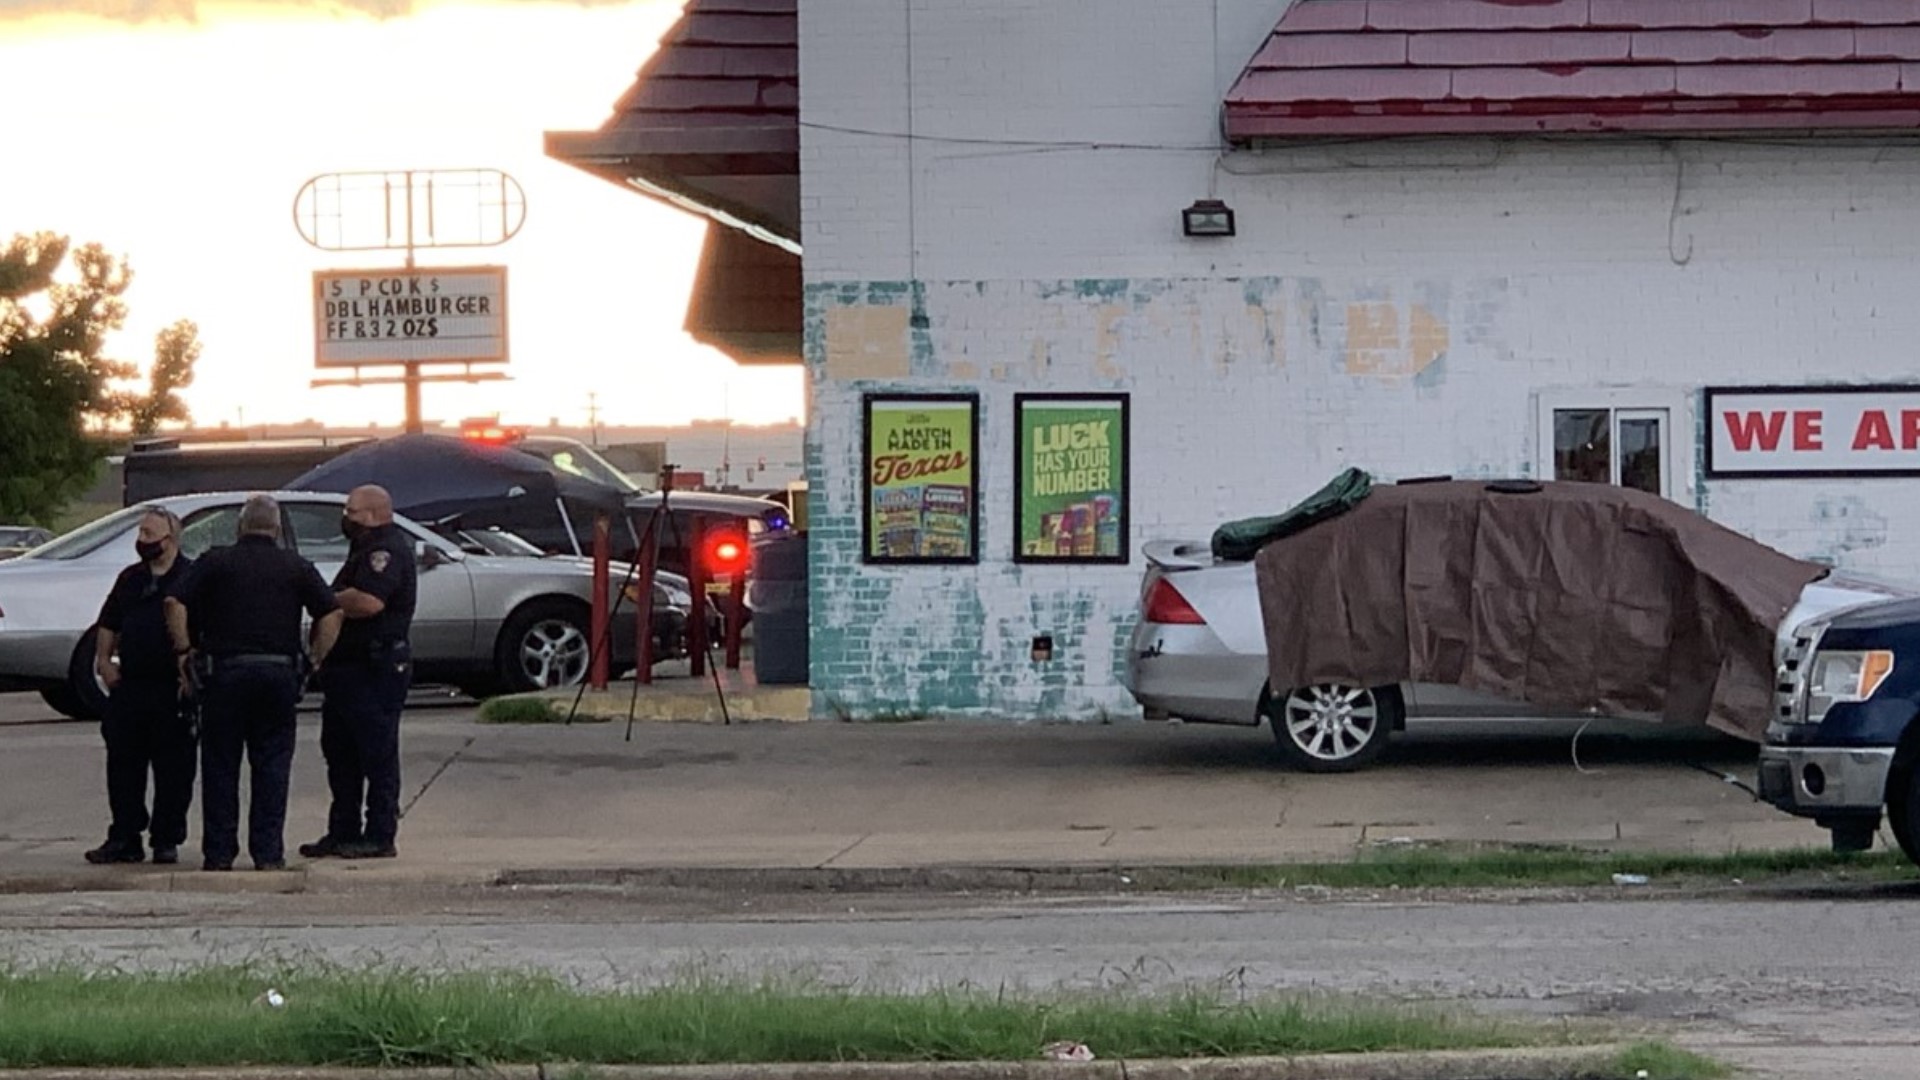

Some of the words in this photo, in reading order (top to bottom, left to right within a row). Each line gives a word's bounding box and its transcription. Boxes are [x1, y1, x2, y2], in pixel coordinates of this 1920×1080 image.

[888, 439, 930, 450] MADE
[935, 438, 951, 450] IN
[889, 428, 899, 440] A
[903, 427, 951, 438] MATCH
[1033, 420, 1110, 453] LUCK
[1723, 410, 1823, 452] WE
[873, 451, 968, 486] Texas
[1033, 451, 1065, 474] HAS
[1067, 447, 1110, 470] YOUR
[1033, 467, 1110, 497] NUMBER
